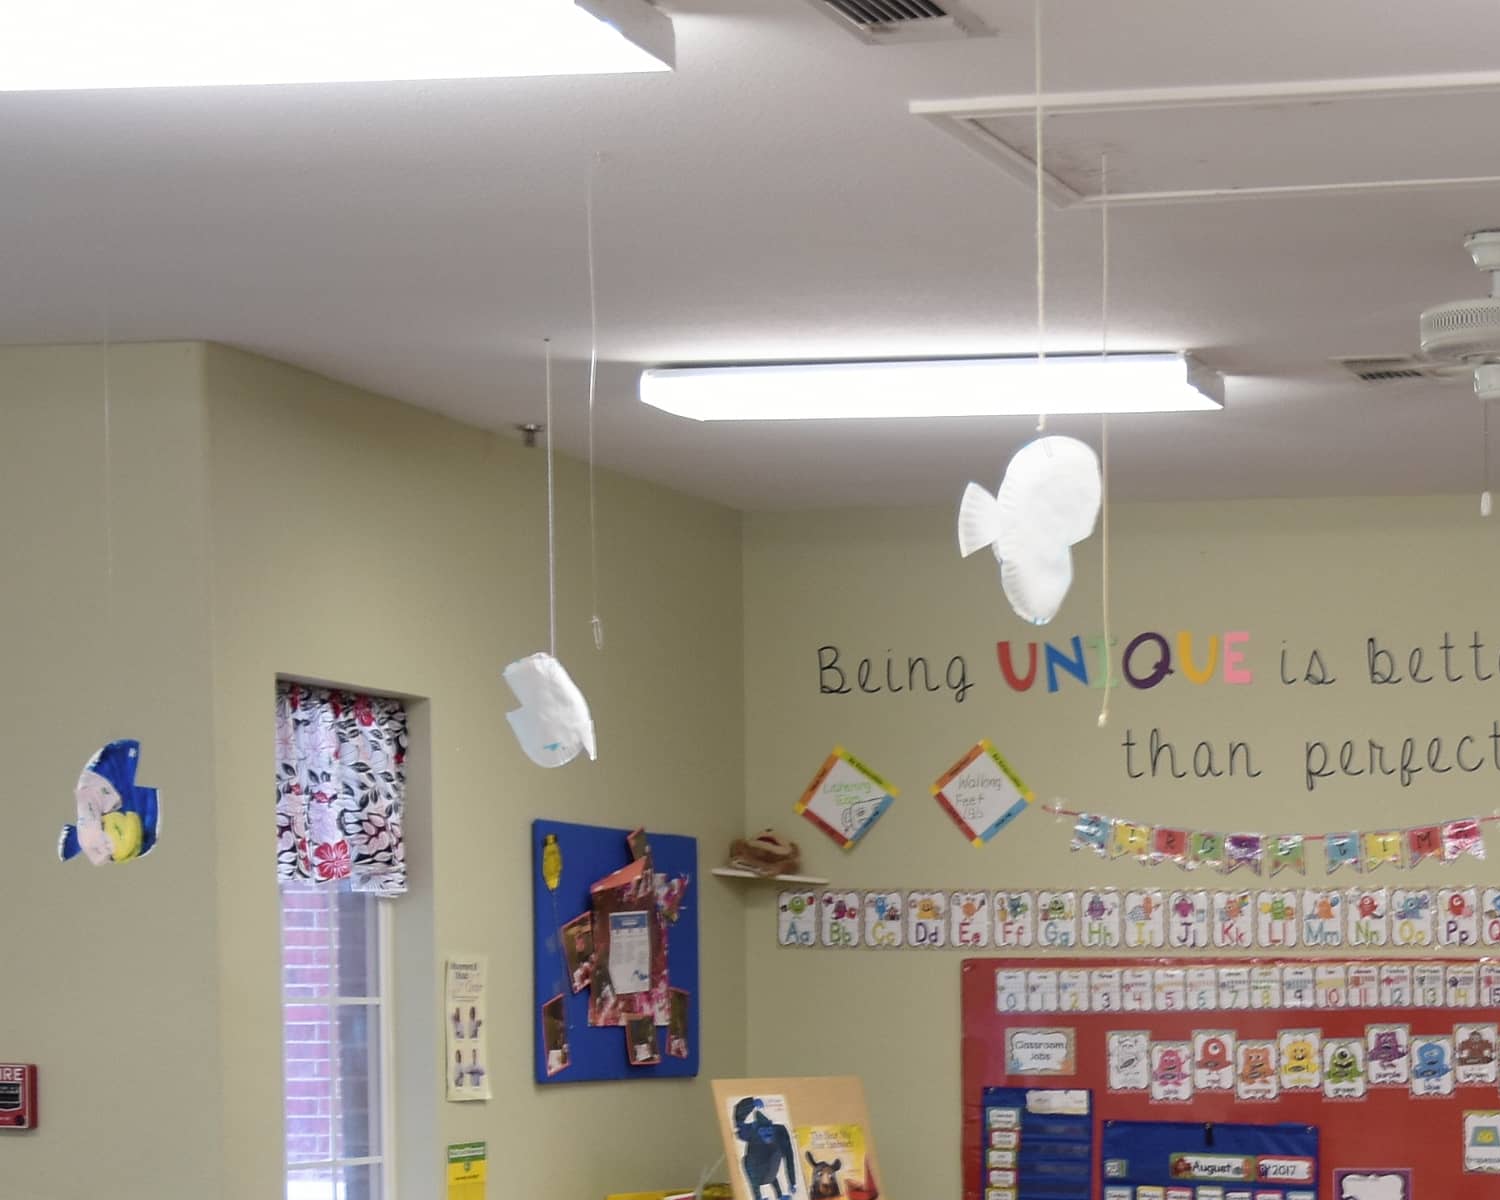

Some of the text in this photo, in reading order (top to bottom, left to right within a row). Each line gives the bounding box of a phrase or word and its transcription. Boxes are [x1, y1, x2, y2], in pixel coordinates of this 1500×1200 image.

[816, 645, 975, 704] Being
[995, 630, 1253, 693] UNIQUE
[1278, 639, 1337, 687] is
[1121, 727, 1263, 780] than
[785, 922, 809, 943] Aa
[831, 922, 850, 944] Bb
[872, 922, 895, 944] Cc
[915, 923, 938, 943] Dd
[959, 922, 981, 943] Ee
[1003, 922, 1024, 943] Ff
[1046, 922, 1069, 945] Gg
[1088, 923, 1112, 944] Hh
[1177, 922, 1197, 948] Jj
[1222, 923, 1244, 944] Kk
[1268, 922, 1287, 944] Ll
[1306, 922, 1339, 943] Mm
[1355, 921, 1380, 943] Nn
[1400, 921, 1425, 942] Oo
[1446, 920, 1469, 944] Pp
[1191, 1161, 1233, 1175] August
